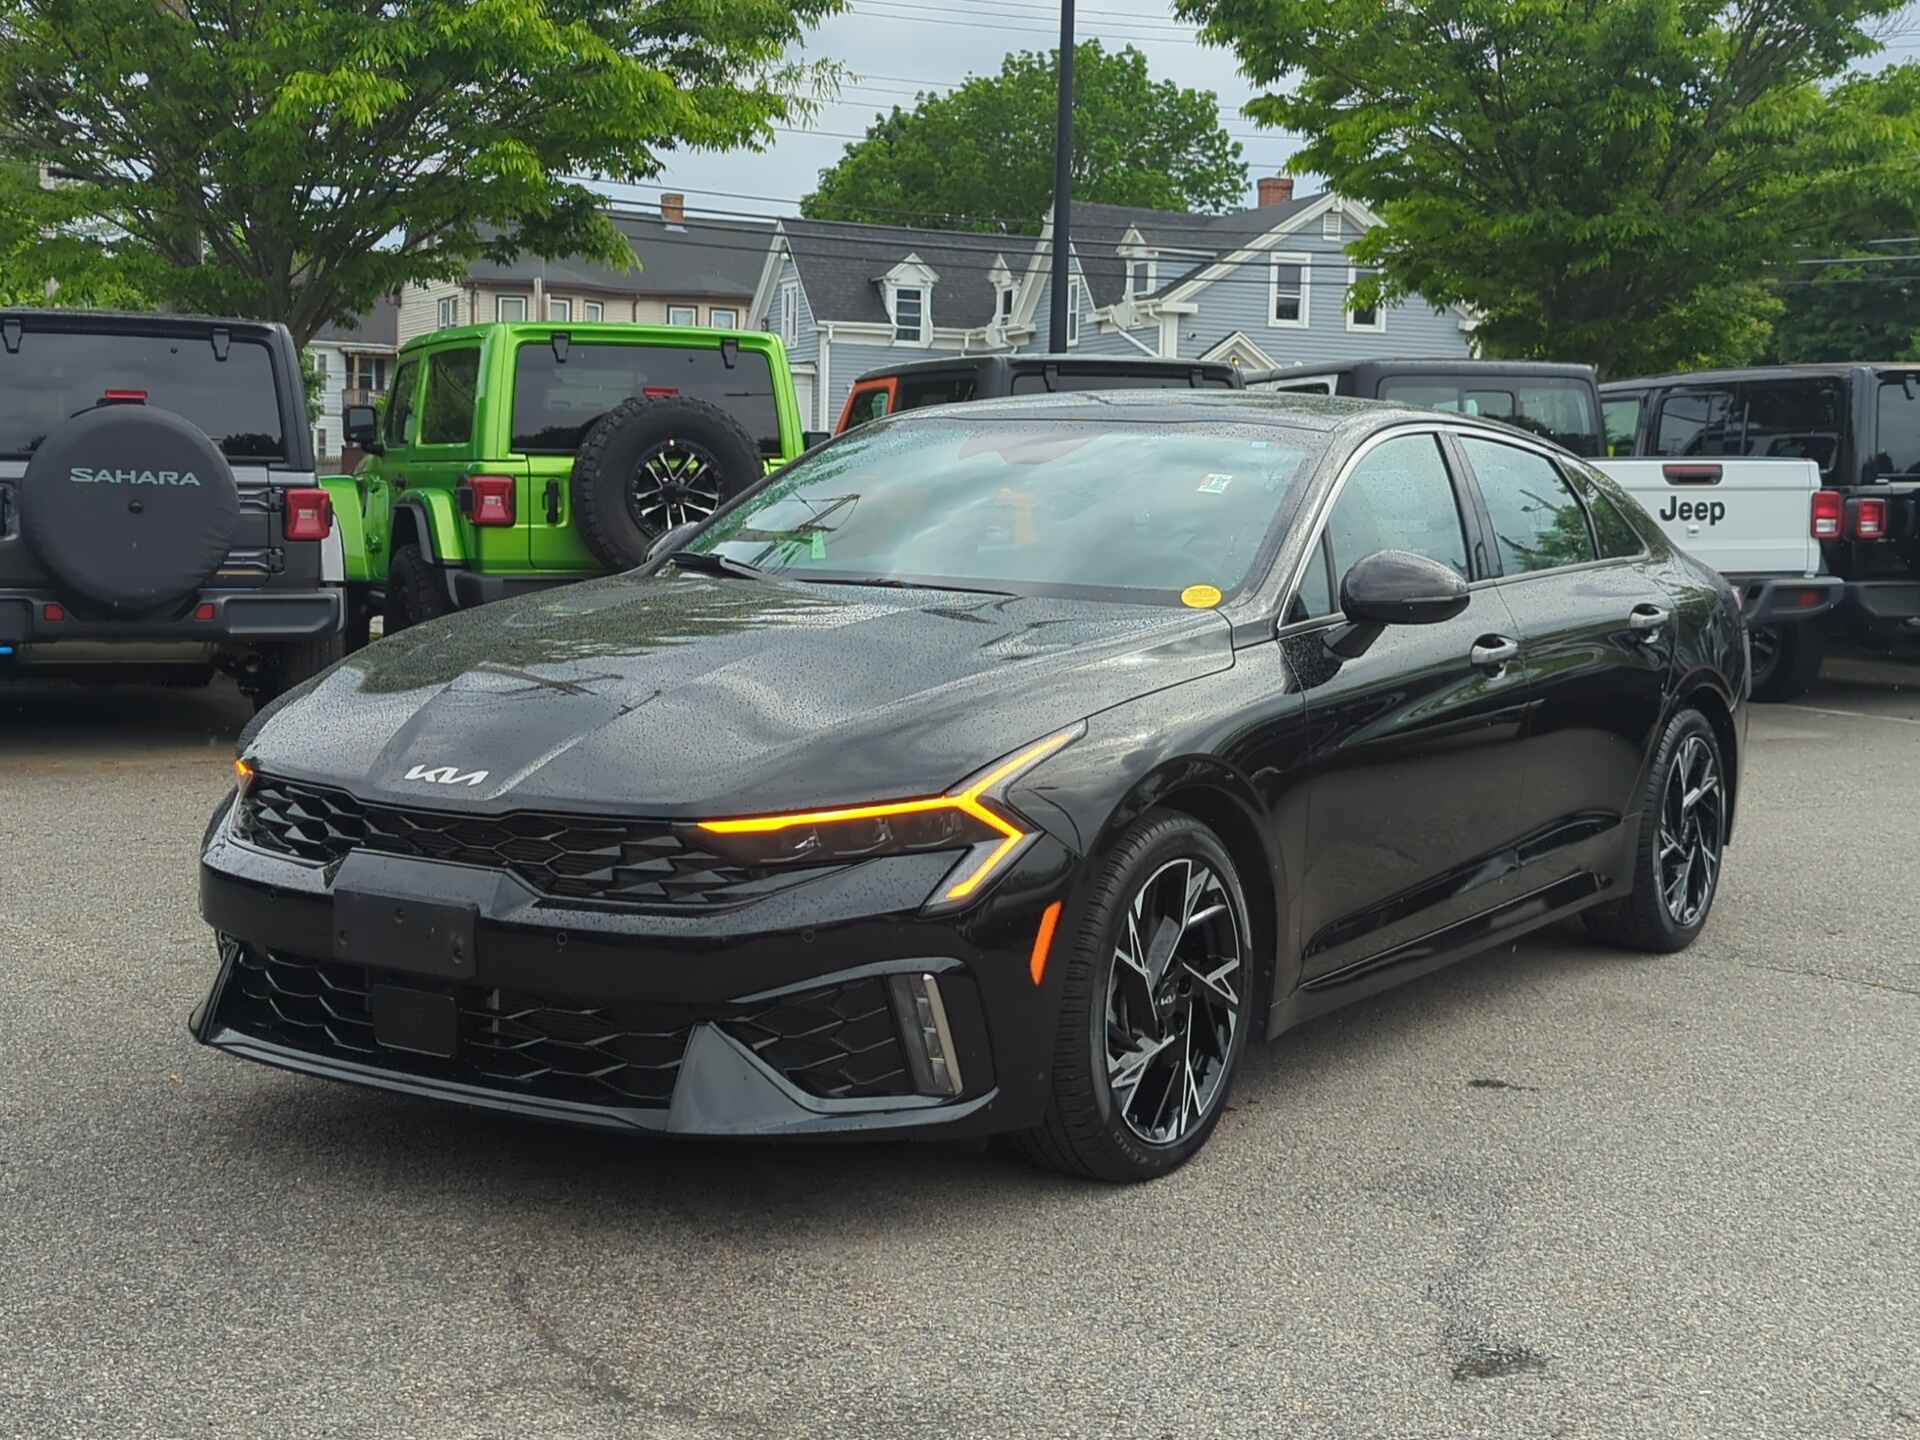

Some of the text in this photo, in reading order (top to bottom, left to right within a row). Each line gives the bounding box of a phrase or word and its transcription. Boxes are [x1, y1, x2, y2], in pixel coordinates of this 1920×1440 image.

[70, 467, 201, 486] SAHARA
[1659, 495, 1725, 526] Jeep
[404, 764, 489, 786] KIA
